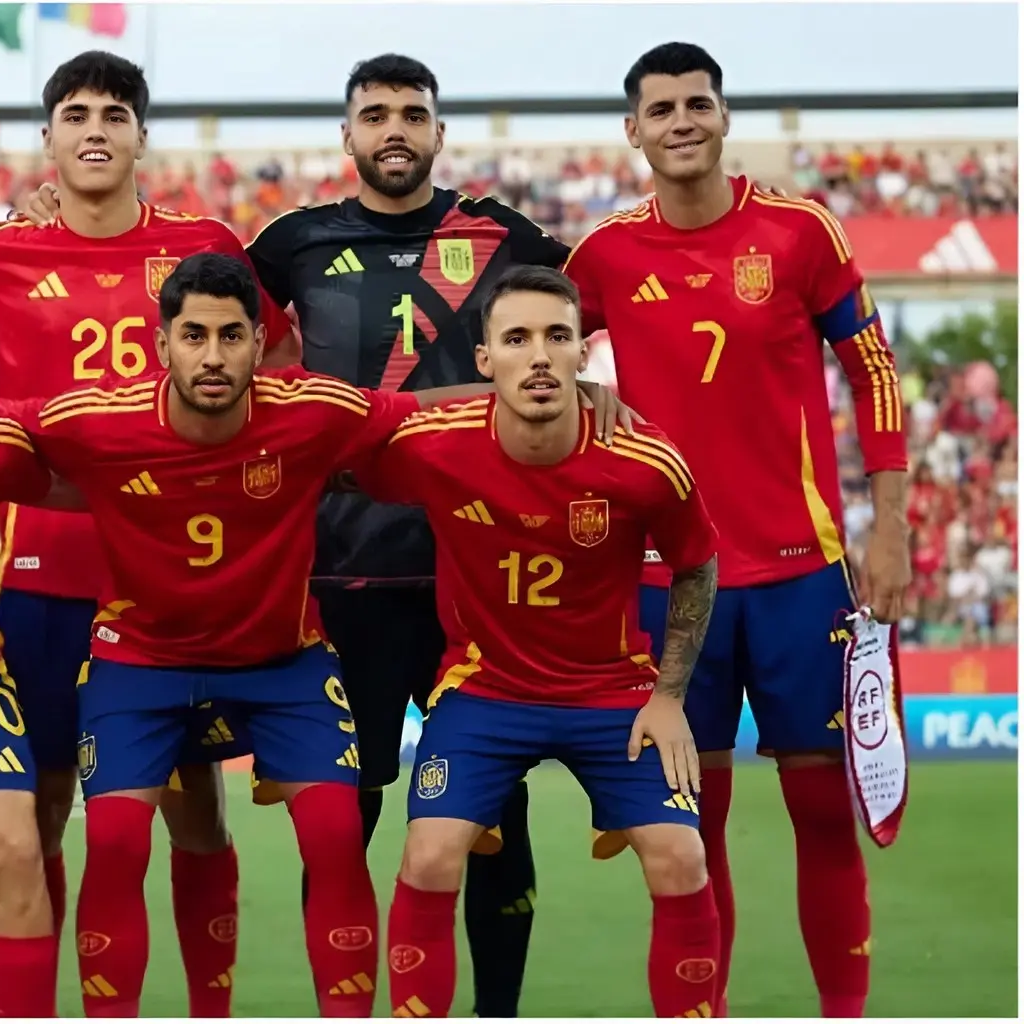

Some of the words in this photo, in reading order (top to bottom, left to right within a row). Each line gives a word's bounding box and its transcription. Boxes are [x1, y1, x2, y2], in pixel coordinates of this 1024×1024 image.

[71, 316, 147, 379] 26
[392, 294, 414, 355] 1
[692, 320, 726, 383] 7
[186, 513, 224, 567] 9
[498, 551, 564, 606] 12
